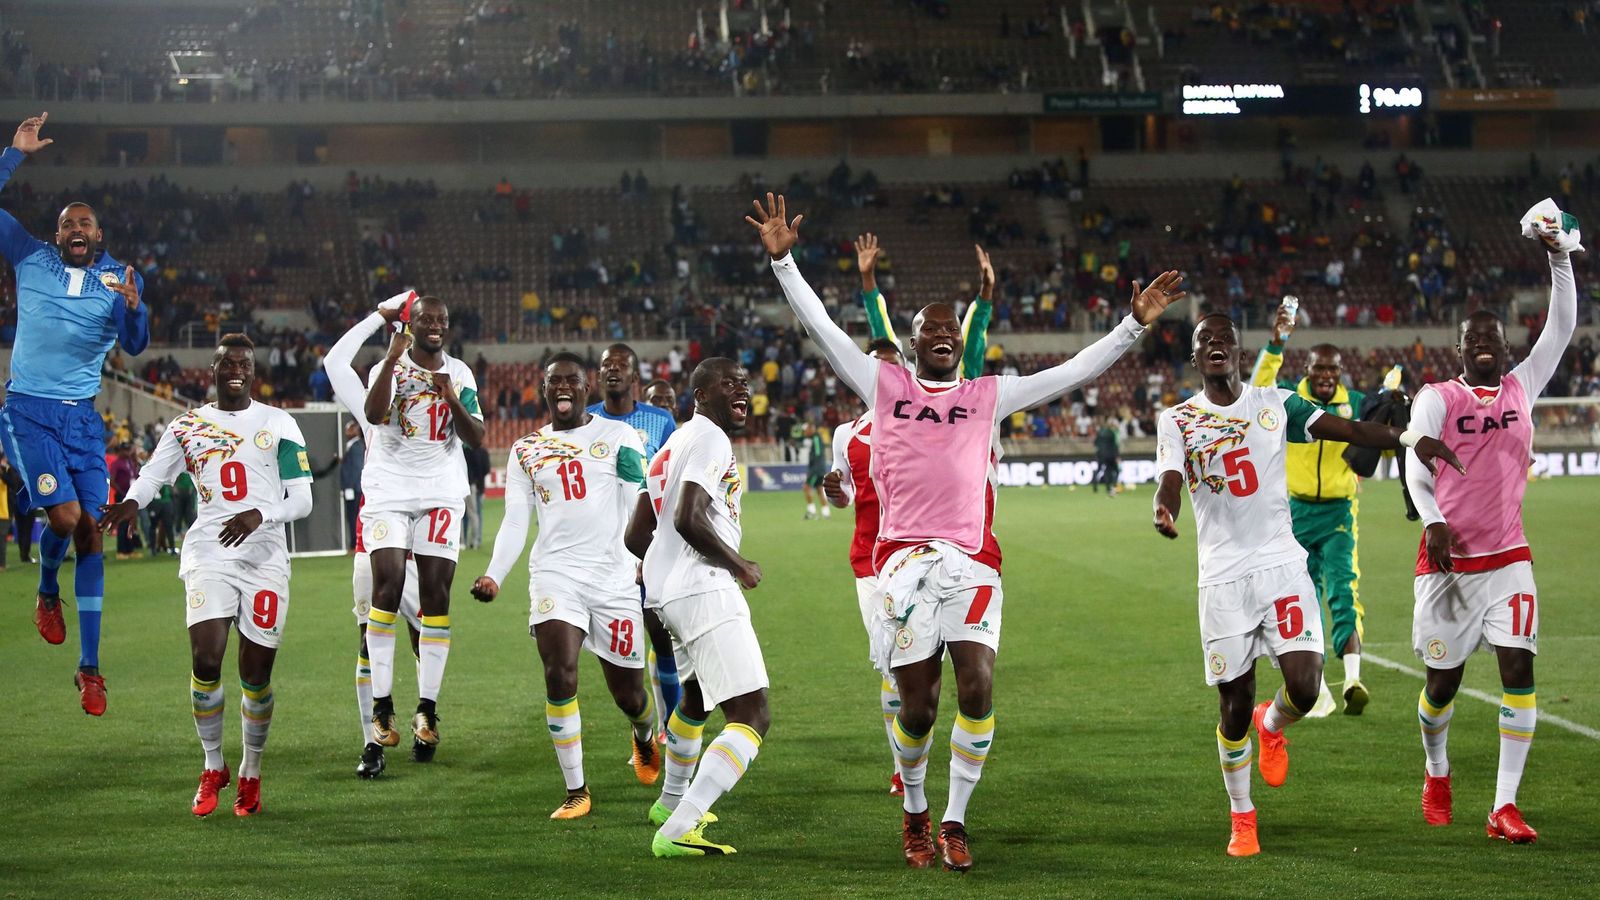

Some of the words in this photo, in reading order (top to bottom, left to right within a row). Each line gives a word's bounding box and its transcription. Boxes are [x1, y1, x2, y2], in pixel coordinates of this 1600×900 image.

[64, 267, 86, 296] 1
[427, 402, 450, 441] 12
[1456, 410, 1519, 434] CAF
[220, 461, 248, 501] 9
[556, 460, 587, 501] 13
[998, 462, 1045, 486] ABC
[1222, 447, 1259, 497] 5
[428, 507, 451, 545] 12
[252, 589, 278, 629] 9
[964, 585, 993, 625] 7
[1273, 595, 1303, 639] 5
[1508, 593, 1534, 637] 17
[608, 618, 633, 657] 13
